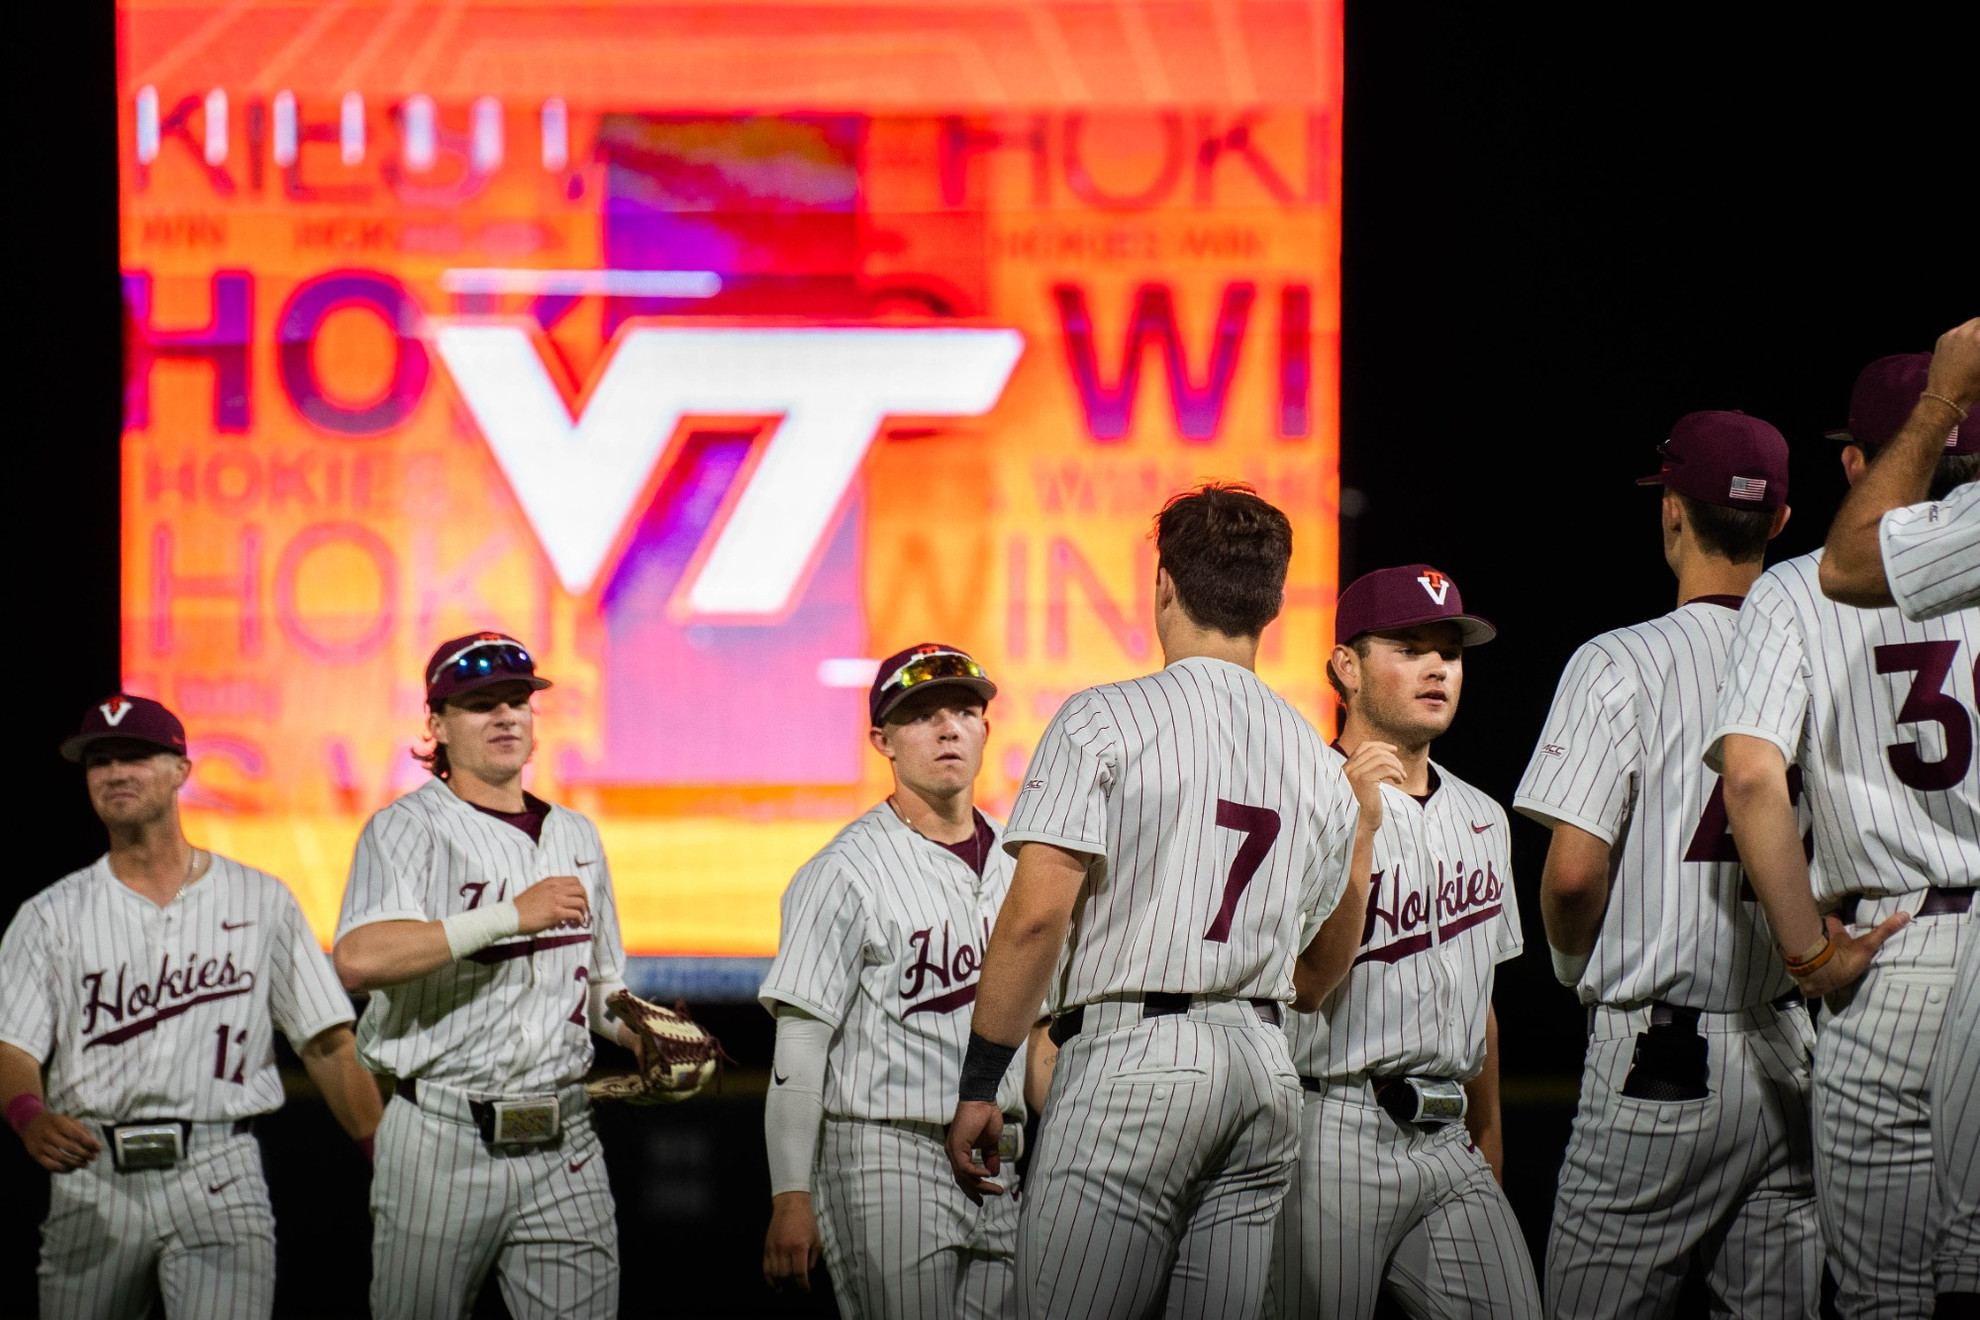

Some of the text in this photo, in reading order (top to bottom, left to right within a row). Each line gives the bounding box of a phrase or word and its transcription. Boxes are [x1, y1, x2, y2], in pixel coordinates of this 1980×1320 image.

[1052, 283, 1311, 440] WI
[430, 322, 1027, 618] VT
[1874, 639, 1980, 792] 3
[1204, 799, 1281, 944] 7
[1360, 860, 1504, 947] Hokies
[82, 951, 254, 1038] Hokies
